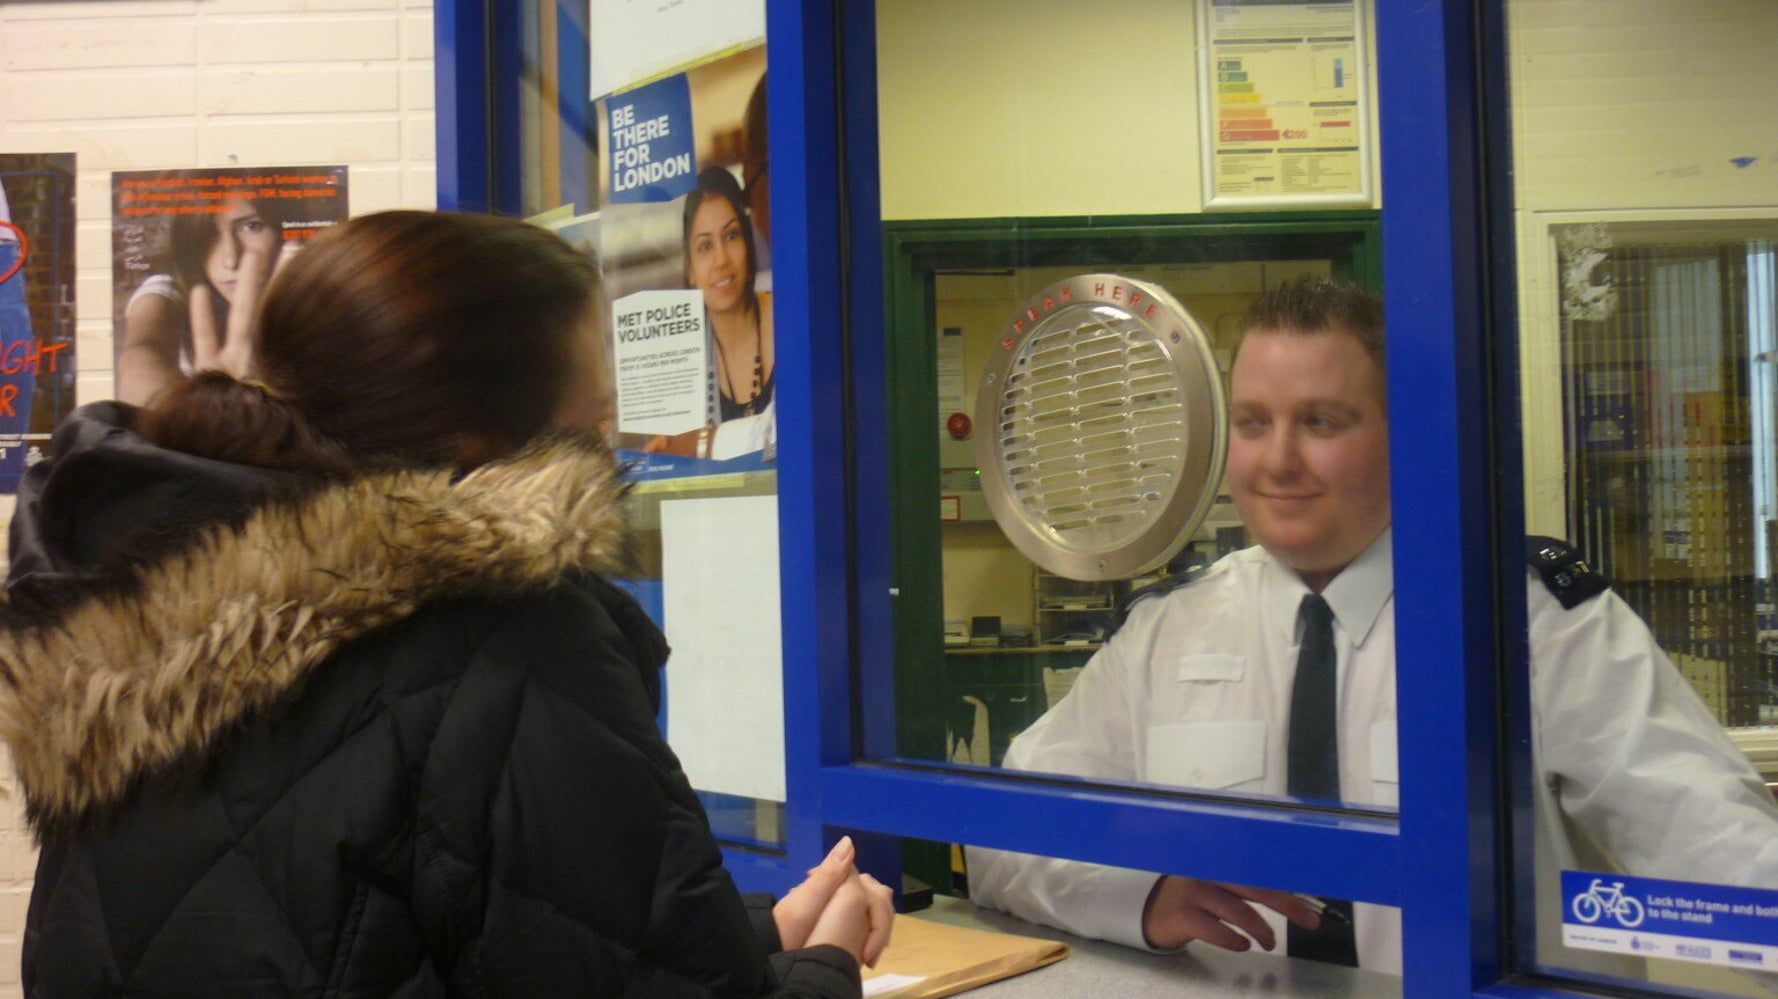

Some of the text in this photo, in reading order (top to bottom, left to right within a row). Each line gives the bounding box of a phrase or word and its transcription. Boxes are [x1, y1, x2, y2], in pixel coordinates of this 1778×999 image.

[612, 104, 635, 129] BE
[613, 114, 670, 149] THERE
[614, 144, 650, 171] FOR
[614, 152, 691, 192] LONDON
[617, 302, 691, 328] MET POLICE
[1002, 283, 1158, 349] SPEAK HERE
[617, 318, 700, 343] VOLUNTEERS
[0, 338, 69, 376] GHT
[1647, 894, 1674, 907] Lock
[1675, 897, 1695, 909] the
[1695, 899, 1730, 913] frame
[1731, 904, 1754, 916] and
[1647, 907, 1713, 924] to the stand
